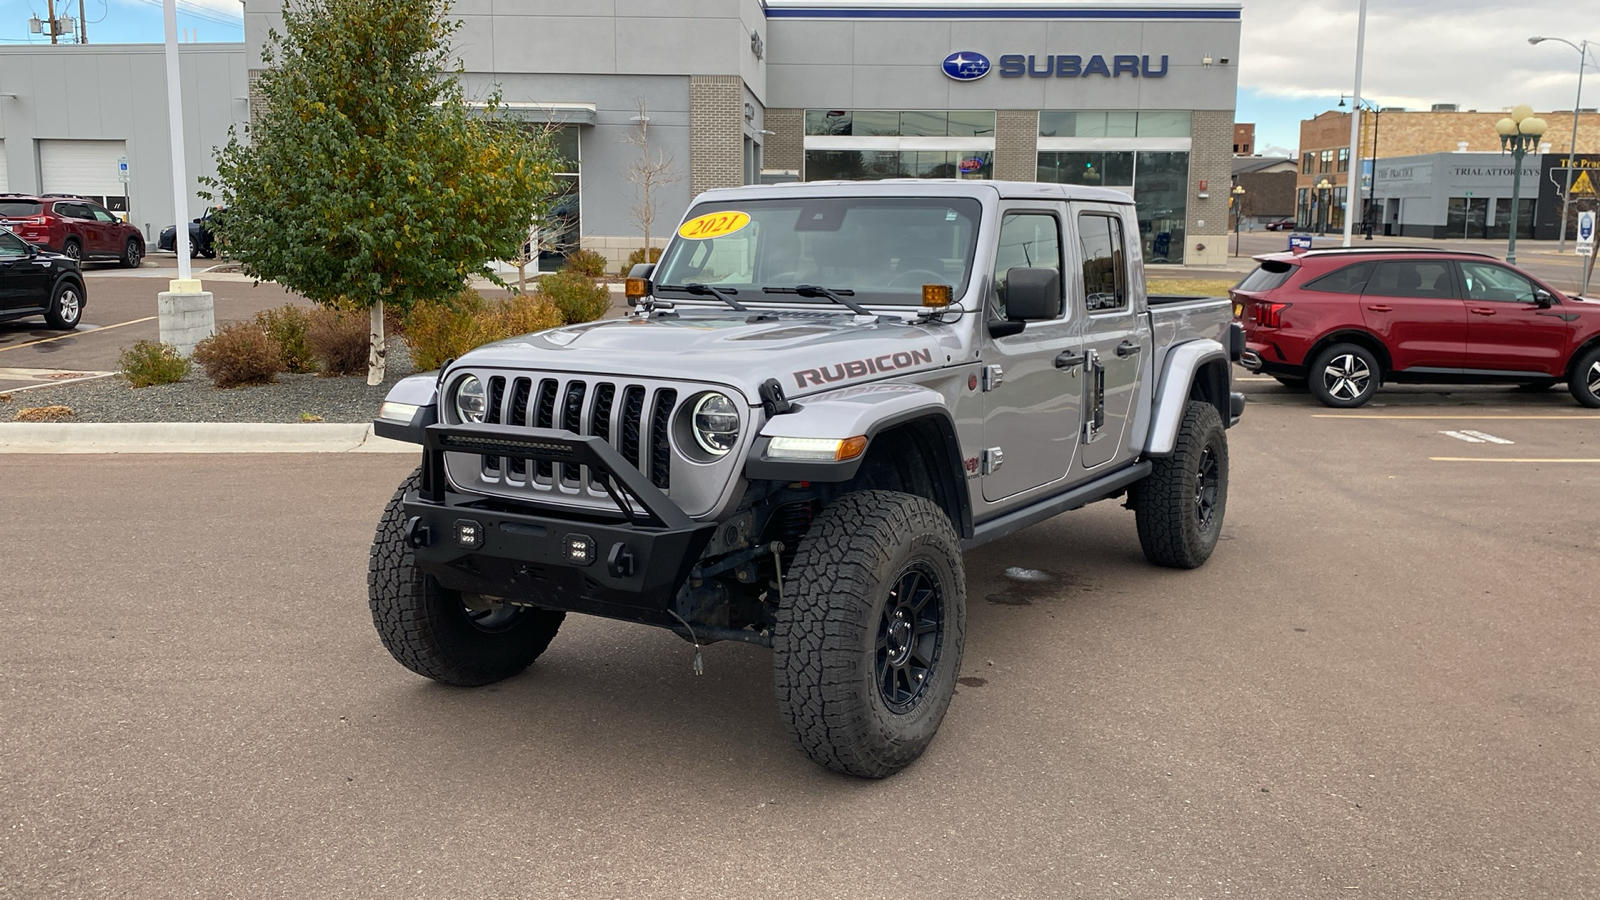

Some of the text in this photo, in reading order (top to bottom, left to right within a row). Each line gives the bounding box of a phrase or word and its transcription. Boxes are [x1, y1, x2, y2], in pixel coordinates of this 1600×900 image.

[999, 54, 1169, 78] SUBARU
[959, 159, 980, 170] OPEN
[1378, 167, 1414, 179] THE PRACTICE
[1454, 168, 1540, 176] TRIAL ATTOREYS
[688, 214, 740, 236] 2021
[793, 348, 932, 389] RUBICON
